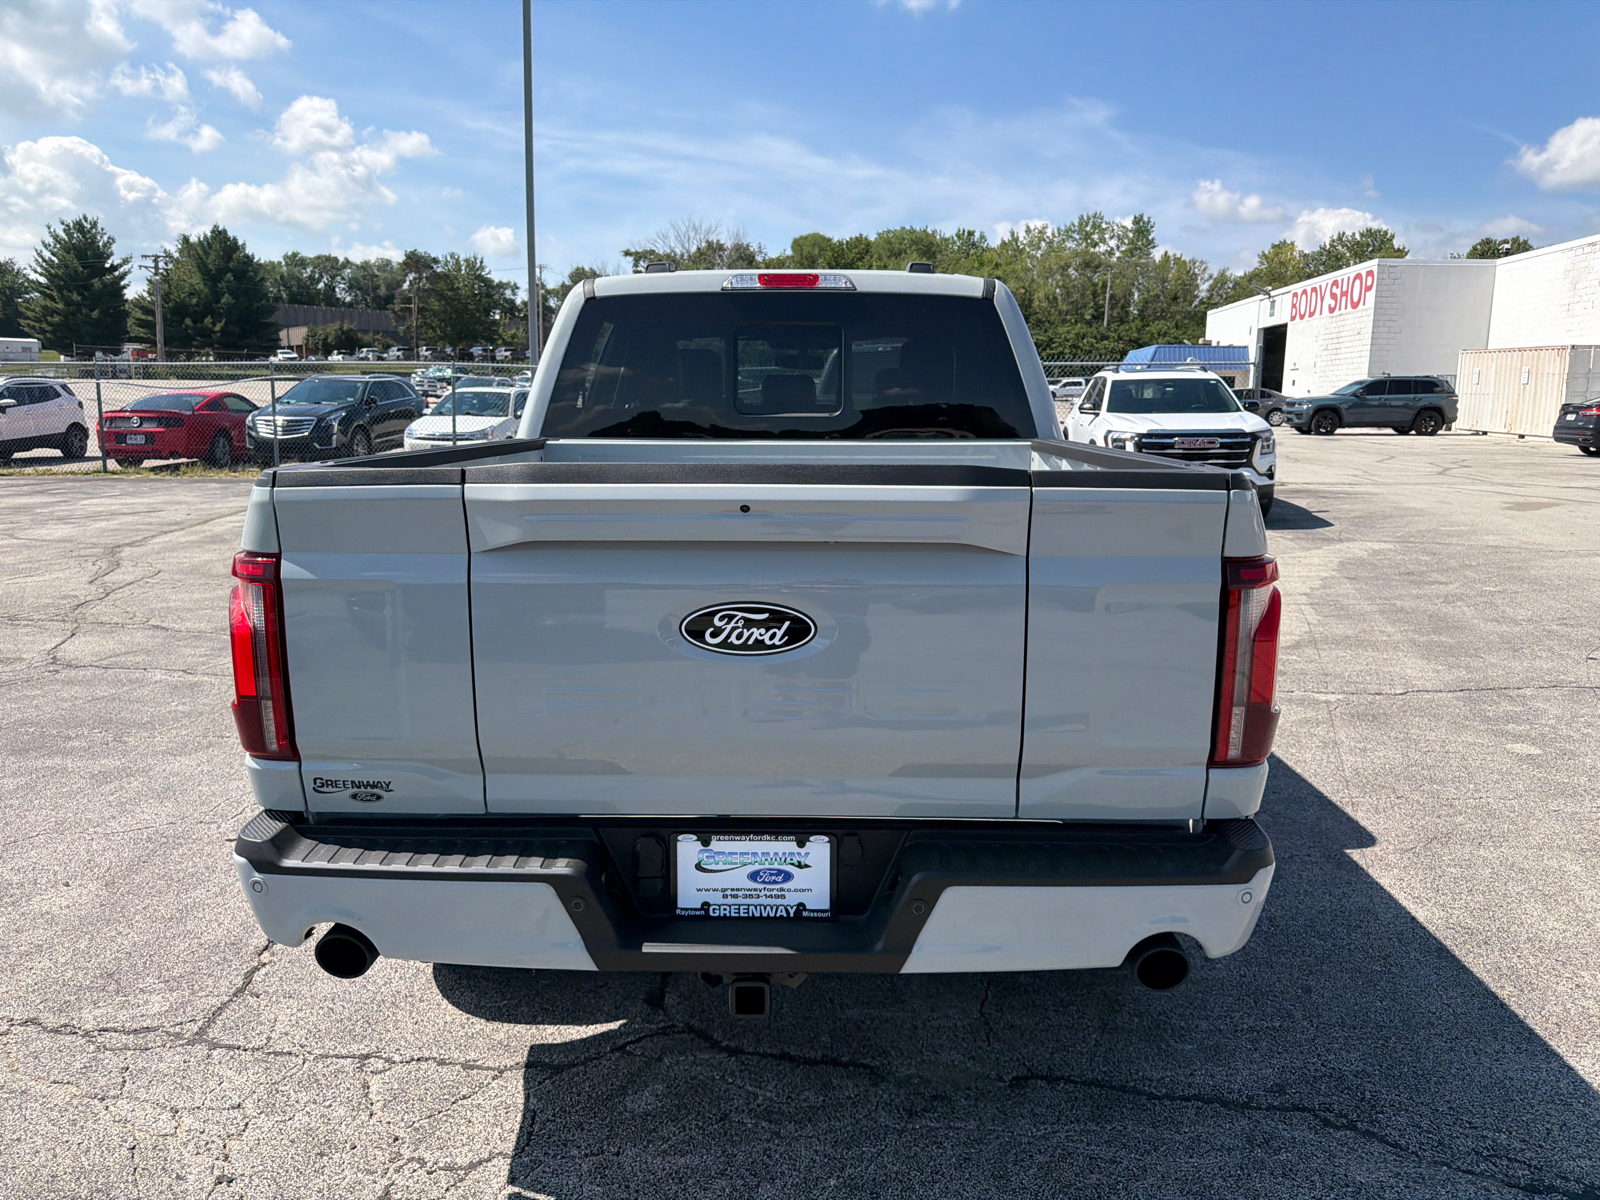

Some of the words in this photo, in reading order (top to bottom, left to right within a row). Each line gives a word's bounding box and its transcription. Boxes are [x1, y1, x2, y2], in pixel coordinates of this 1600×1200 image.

[705, 610, 791, 646] Ford
[711, 834, 796, 842] greenwayfordkc.com
[757, 869, 784, 883] Ford
[676, 908, 705, 917] Raytown
[709, 904, 798, 918] GREENWAY
[802, 910, 831, 918] Missouri
